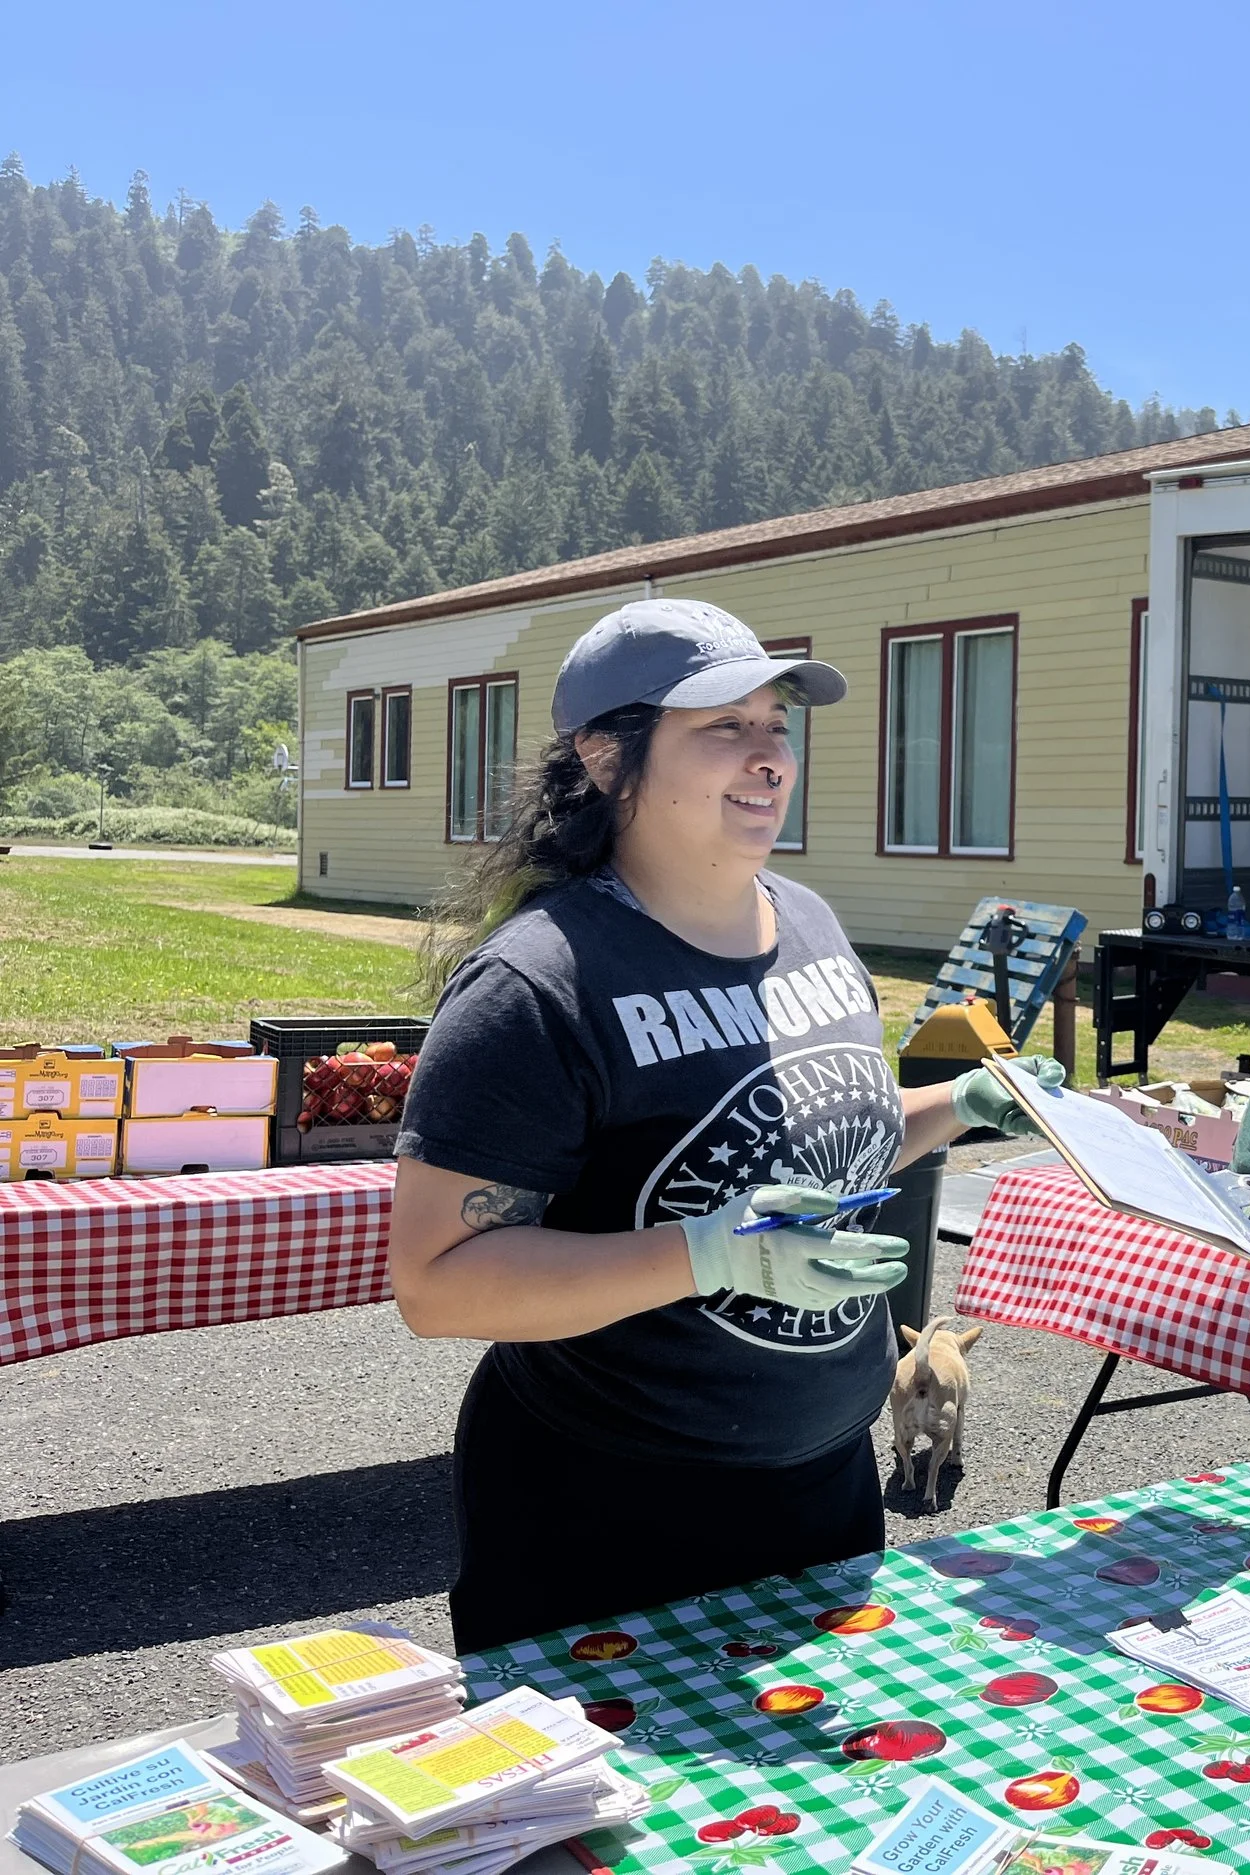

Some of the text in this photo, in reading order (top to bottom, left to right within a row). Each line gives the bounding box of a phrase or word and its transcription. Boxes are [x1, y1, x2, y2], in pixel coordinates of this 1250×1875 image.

[612, 955, 872, 1067] RAMONES
[727, 1051, 889, 1145] JOHNNY
[1172, 1127, 1199, 1148] PAC
[787, 1176, 819, 1189] HEY HO
[71, 1758, 170, 1797] Cultive su
[79, 1766, 183, 1806] Jardin con
[95, 1778, 185, 1810] CalFresh
[882, 1799, 944, 1861] Grow Your
[897, 1807, 967, 1873] Garden with
[925, 1826, 977, 1873] CalFresh
[255, 1845, 295, 1864] People
